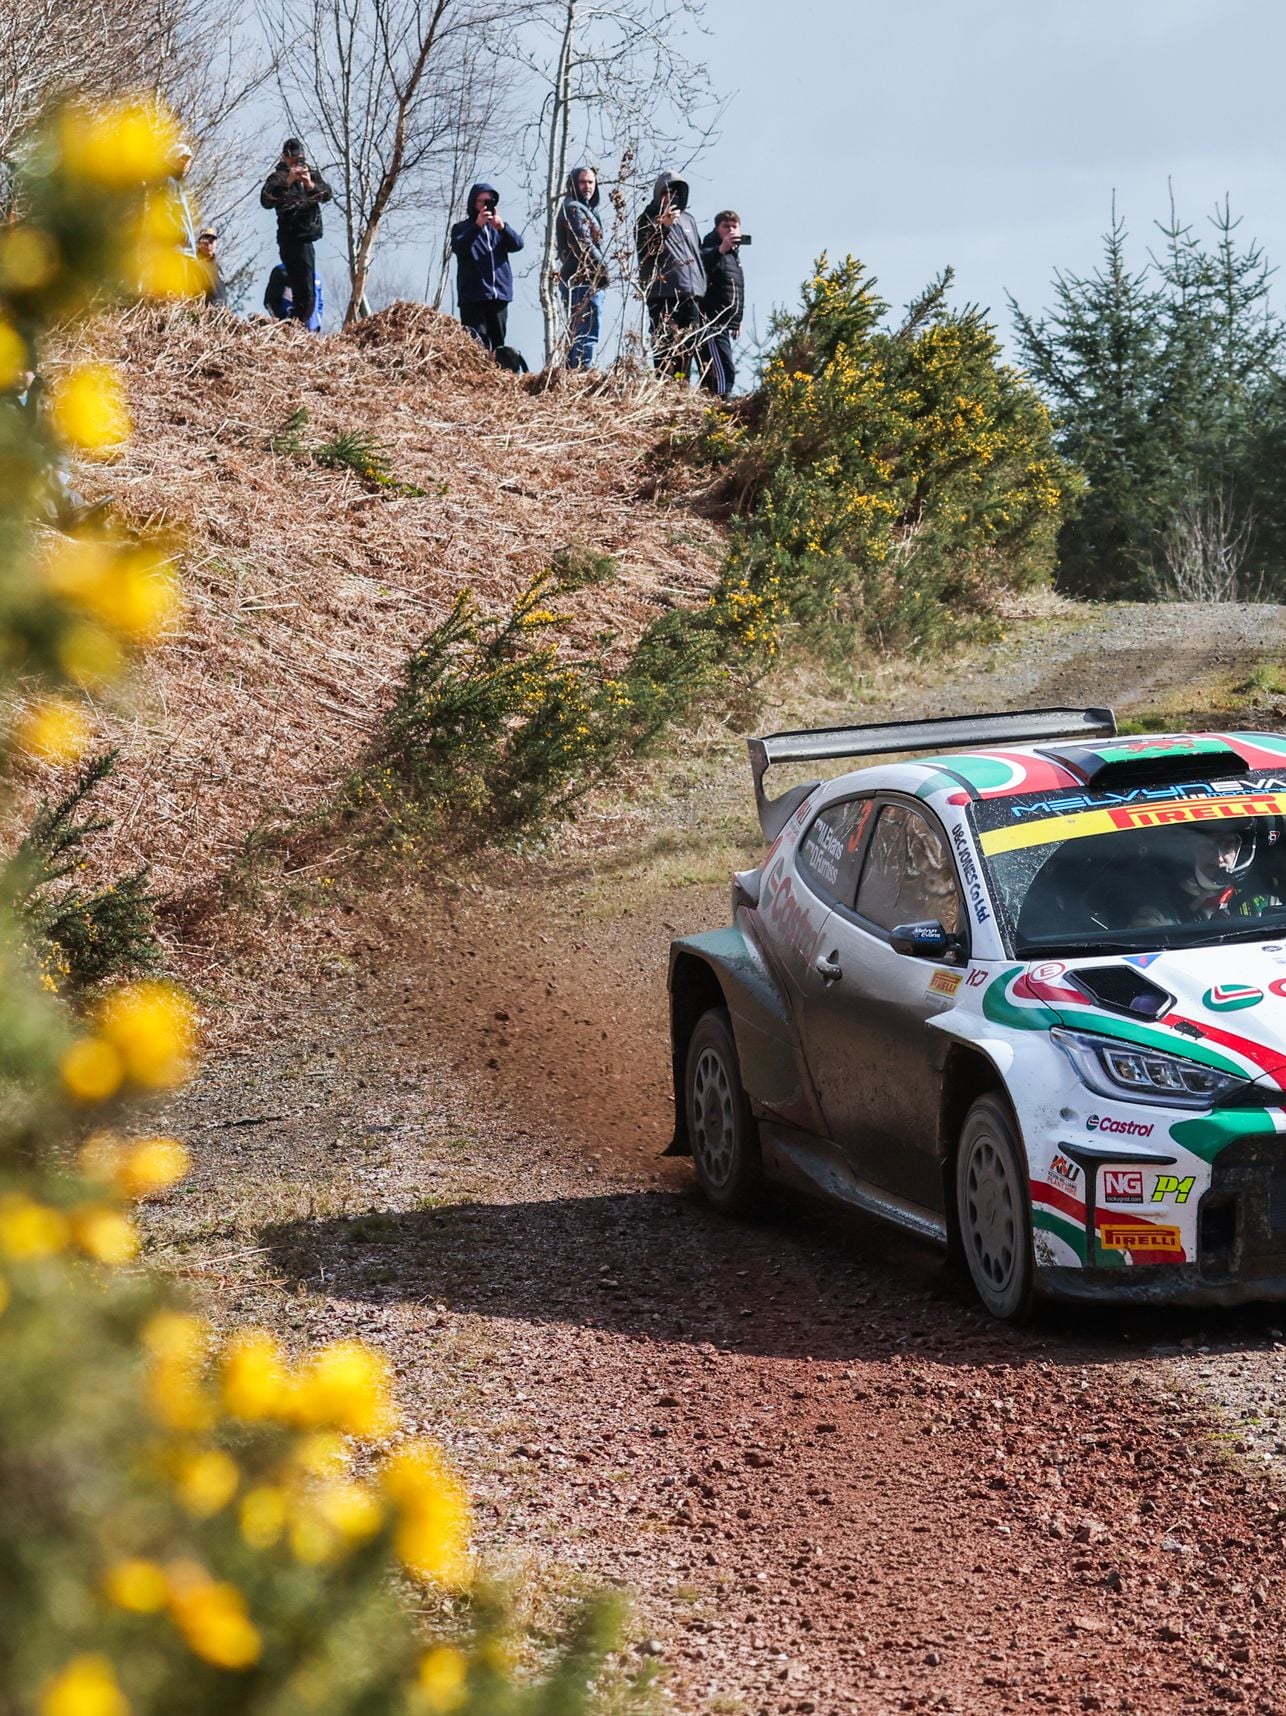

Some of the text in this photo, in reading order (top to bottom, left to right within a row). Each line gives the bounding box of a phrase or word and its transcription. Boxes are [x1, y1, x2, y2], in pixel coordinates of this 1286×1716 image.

[1107, 795, 1282, 829] PIRELLI
[958, 847, 978, 886] JONES
[969, 883, 981, 902] Co
[974, 898, 990, 924] Ltd
[931, 972, 960, 993] PIRELLI
[1100, 1117, 1154, 1137] Castrol
[1106, 1173, 1141, 1194] NG
[1151, 1174, 1196, 1203] P1
[1105, 1229, 1176, 1246] PIRELLI
